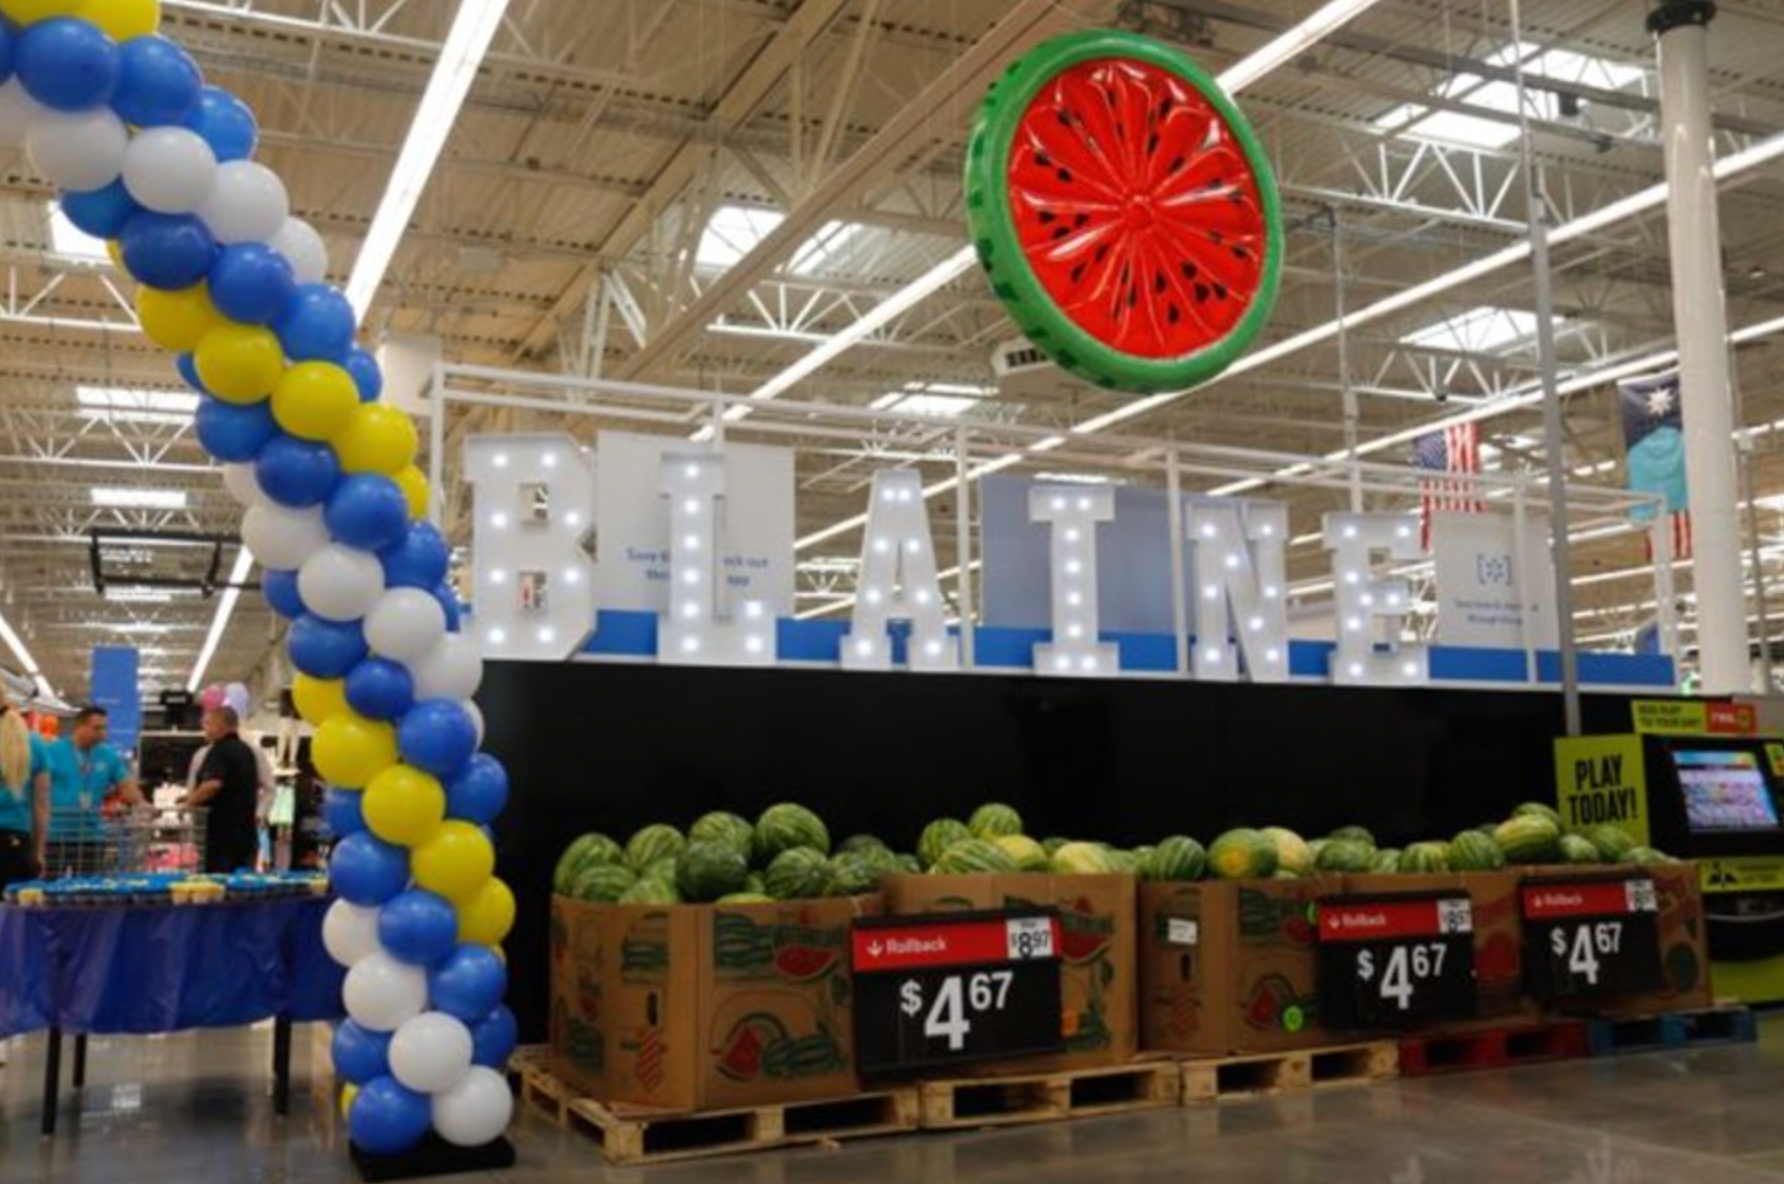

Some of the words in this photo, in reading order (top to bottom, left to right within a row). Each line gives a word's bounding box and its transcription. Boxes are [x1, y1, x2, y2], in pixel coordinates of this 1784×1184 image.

[464, 432, 1429, 688] BLAINE
[1575, 754, 1622, 790] PLAY
[1568, 787, 1638, 826] TODAY!
[886, 935, 948, 954] Rollback
